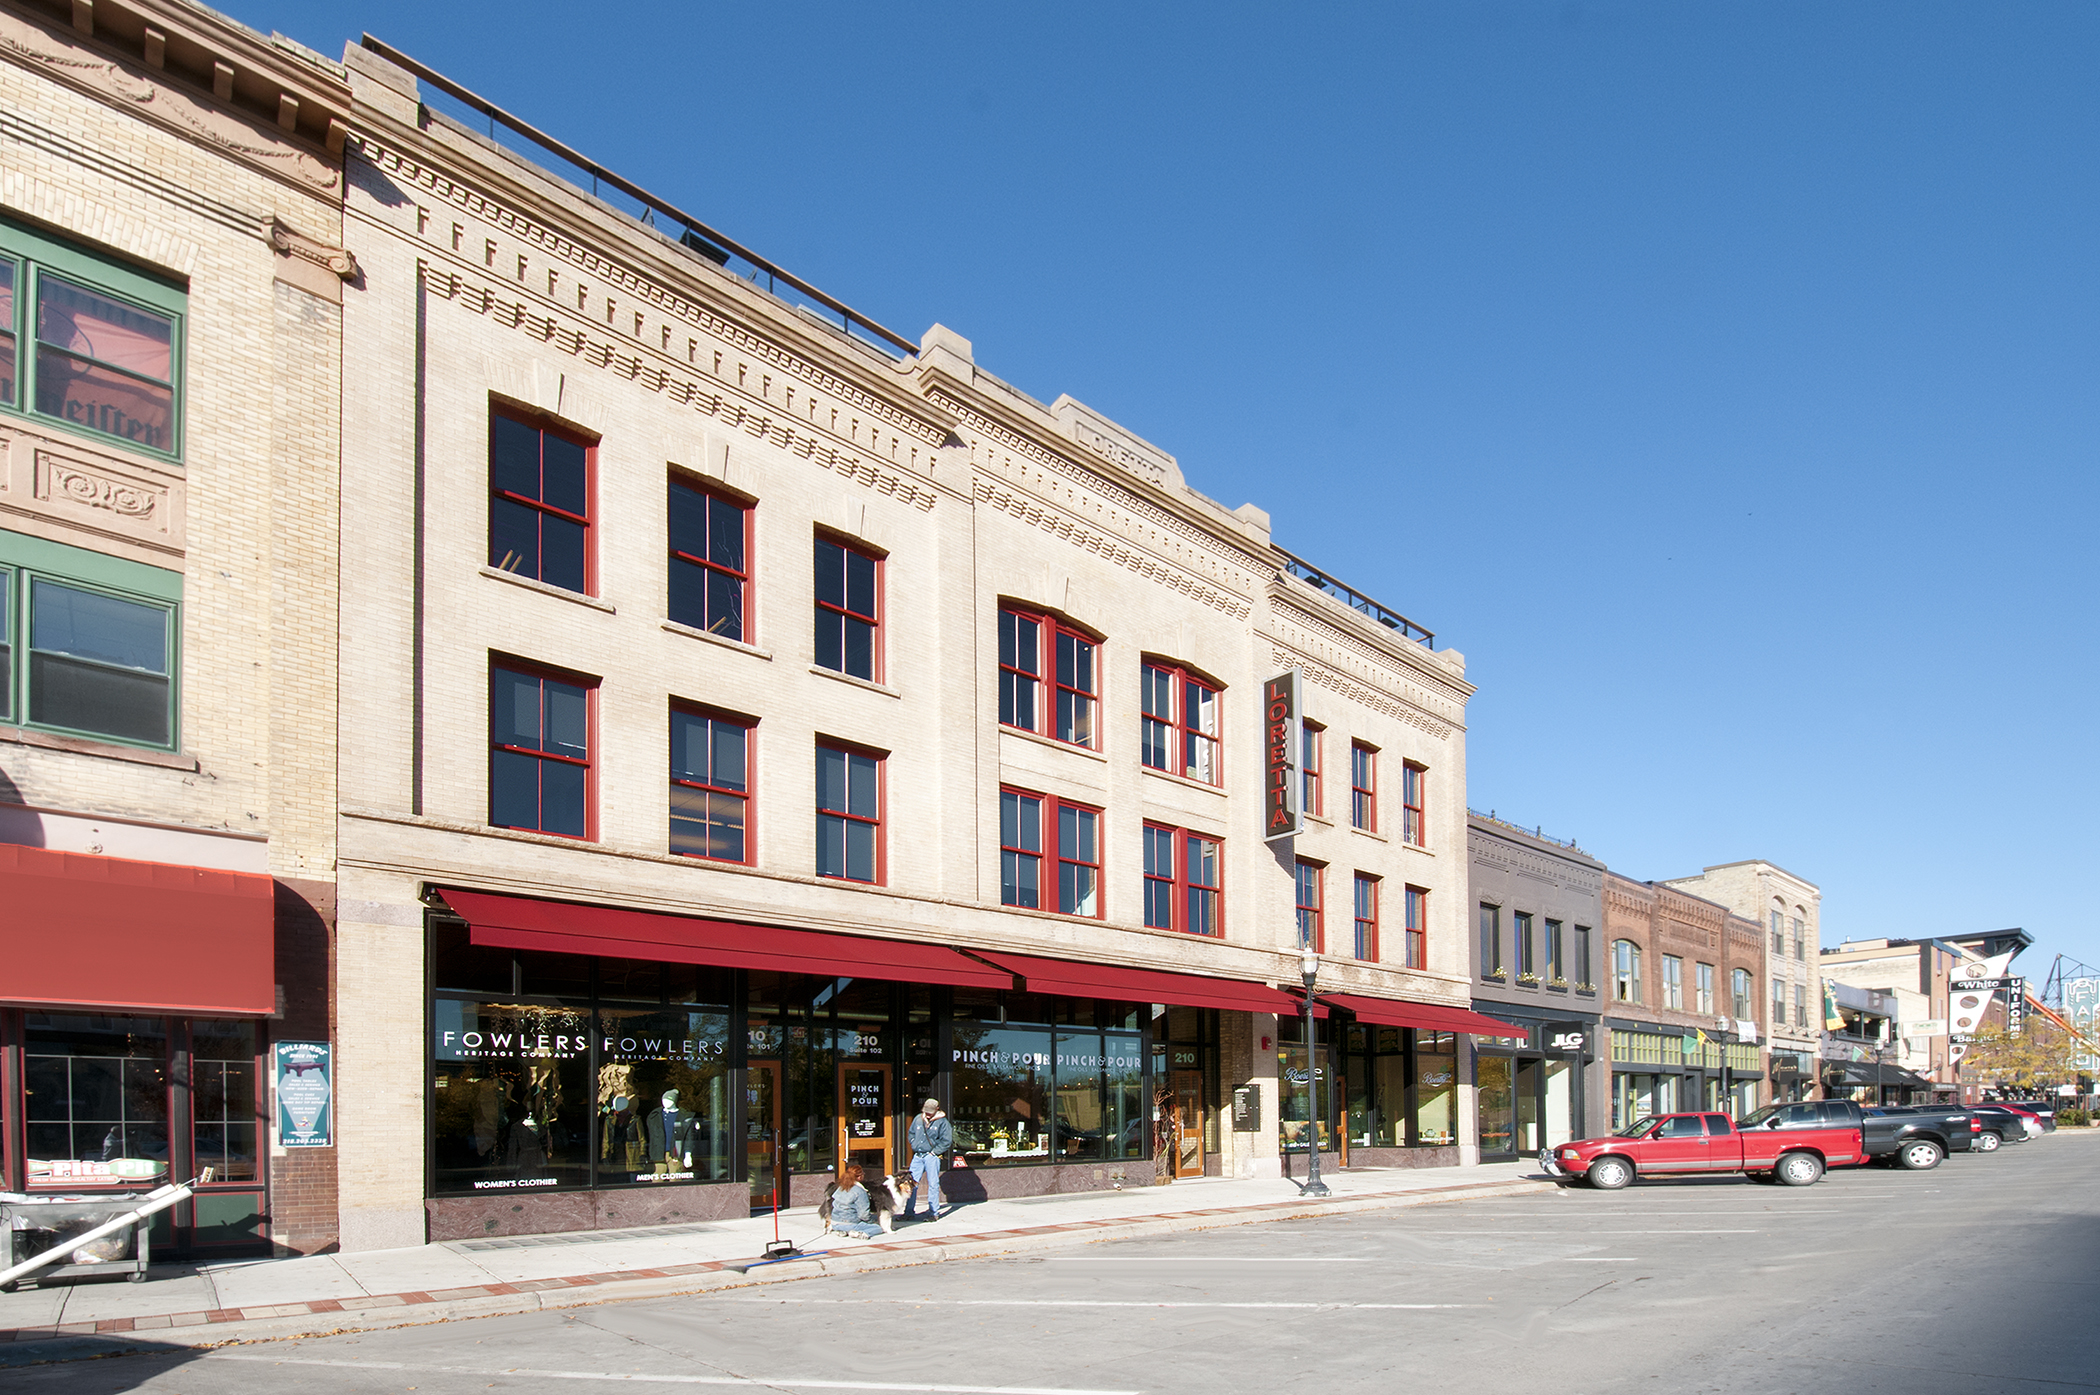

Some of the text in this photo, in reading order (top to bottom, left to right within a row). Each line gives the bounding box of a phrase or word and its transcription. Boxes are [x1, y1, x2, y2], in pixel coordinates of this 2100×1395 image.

[1077, 424, 1164, 488] LORETTA
[1268, 683, 1289, 829] LORETTA
[1957, 980, 2000, 989] White
[2009, 979, 2021, 1040] UNIFORMS
[443, 1031, 586, 1050] FOWLERS
[604, 1037, 723, 1055] FOWLERS
[854, 1035, 878, 1046] 210
[1550, 1032, 1584, 1047] JLG
[278, 1043, 328, 1056] BILLIARDS
[455, 1049, 575, 1059] HERITAGE COMPANY
[953, 1050, 1050, 1065] PINCH & POUR
[1057, 1054, 1141, 1068] PINCH & POUR
[1174, 1053, 1195, 1063] 210
[850, 1085, 879, 1093] PINCH
[851, 1097, 878, 1105] POUR
[53, 1161, 110, 1176] Pita
[117, 1160, 156, 1175] Pit
[636, 1171, 694, 1182] MEN'S CLOTHIER
[474, 1178, 557, 1189] WOMEN'S CLOTHIER
